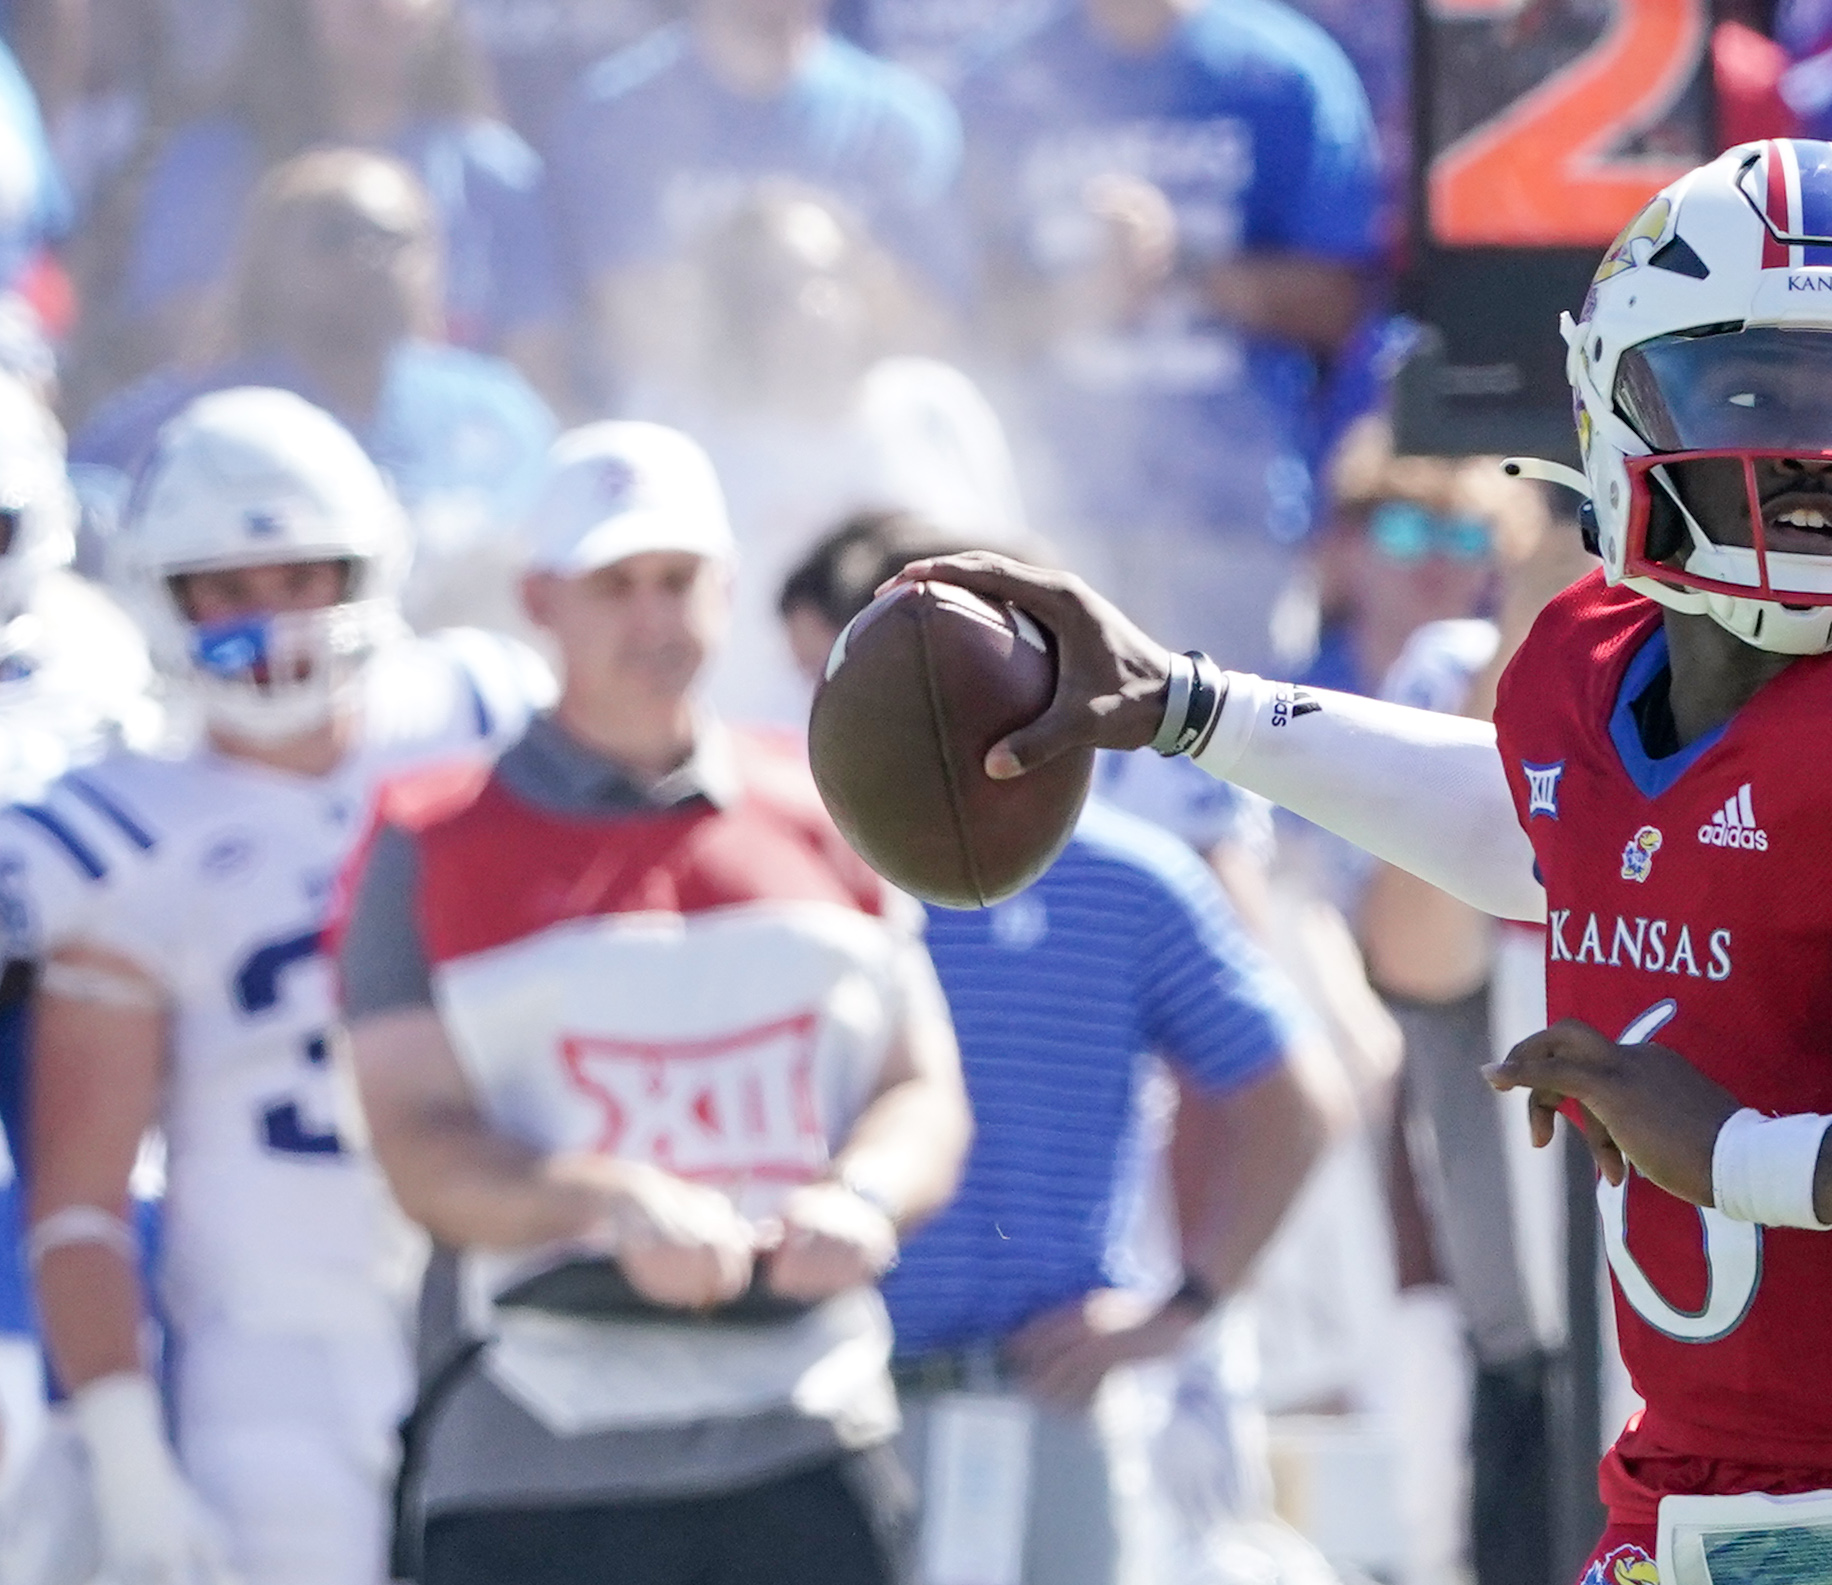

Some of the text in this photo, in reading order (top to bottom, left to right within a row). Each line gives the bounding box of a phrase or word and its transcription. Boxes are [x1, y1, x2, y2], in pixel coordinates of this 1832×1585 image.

[1426, 0, 1708, 247] 2
[1523, 760, 1565, 820] XII
[1697, 822, 1769, 851] adidas
[1550, 908, 1732, 981] KANSAS
